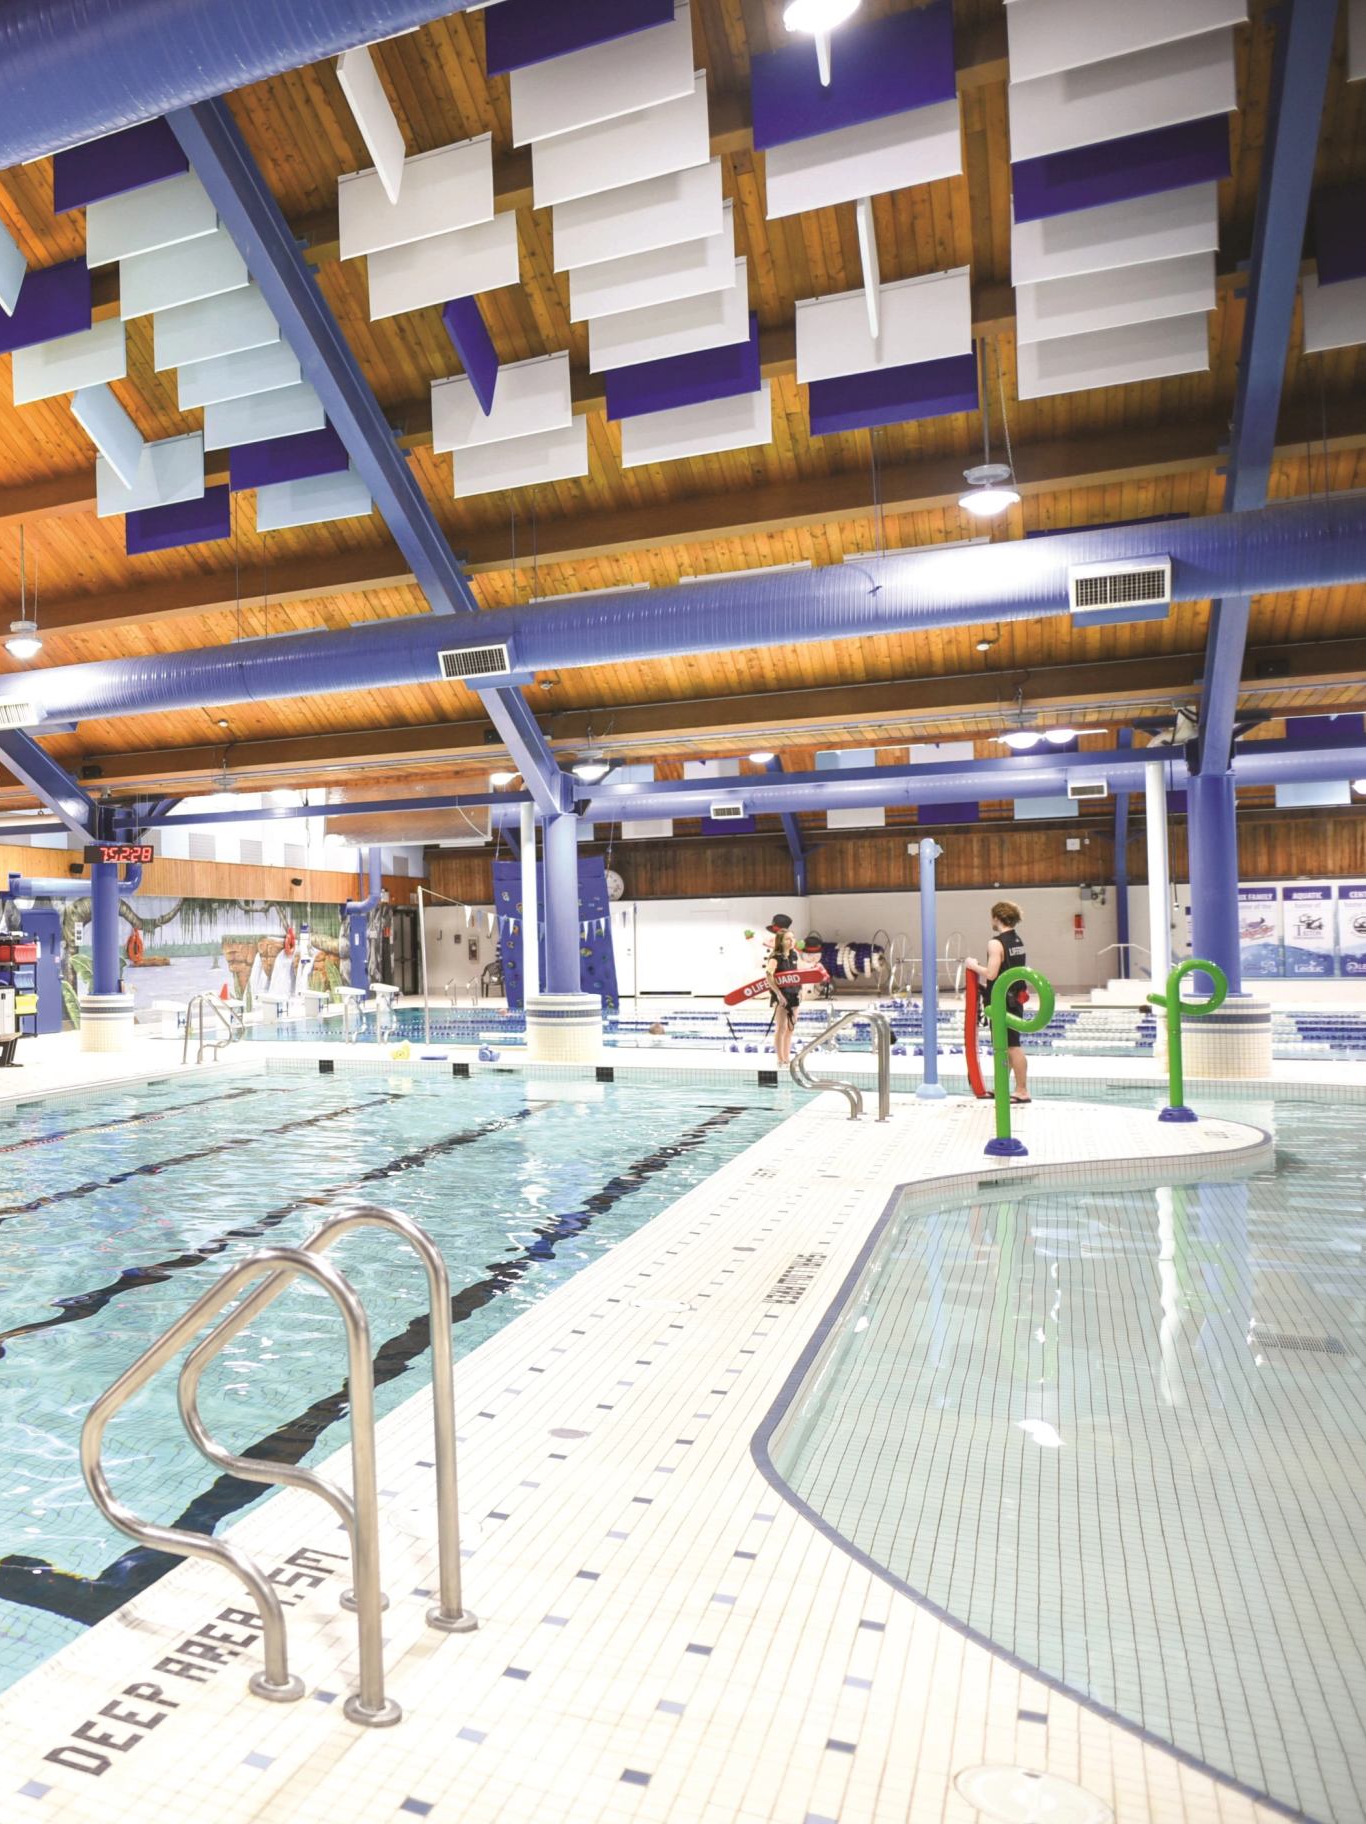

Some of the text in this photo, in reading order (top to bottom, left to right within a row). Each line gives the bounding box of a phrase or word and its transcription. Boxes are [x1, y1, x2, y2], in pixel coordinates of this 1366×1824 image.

[751, 974, 801, 993] LIFEUARD
[42, 1682, 180, 1777] DEEP
[152, 1607, 264, 1683] AREA
